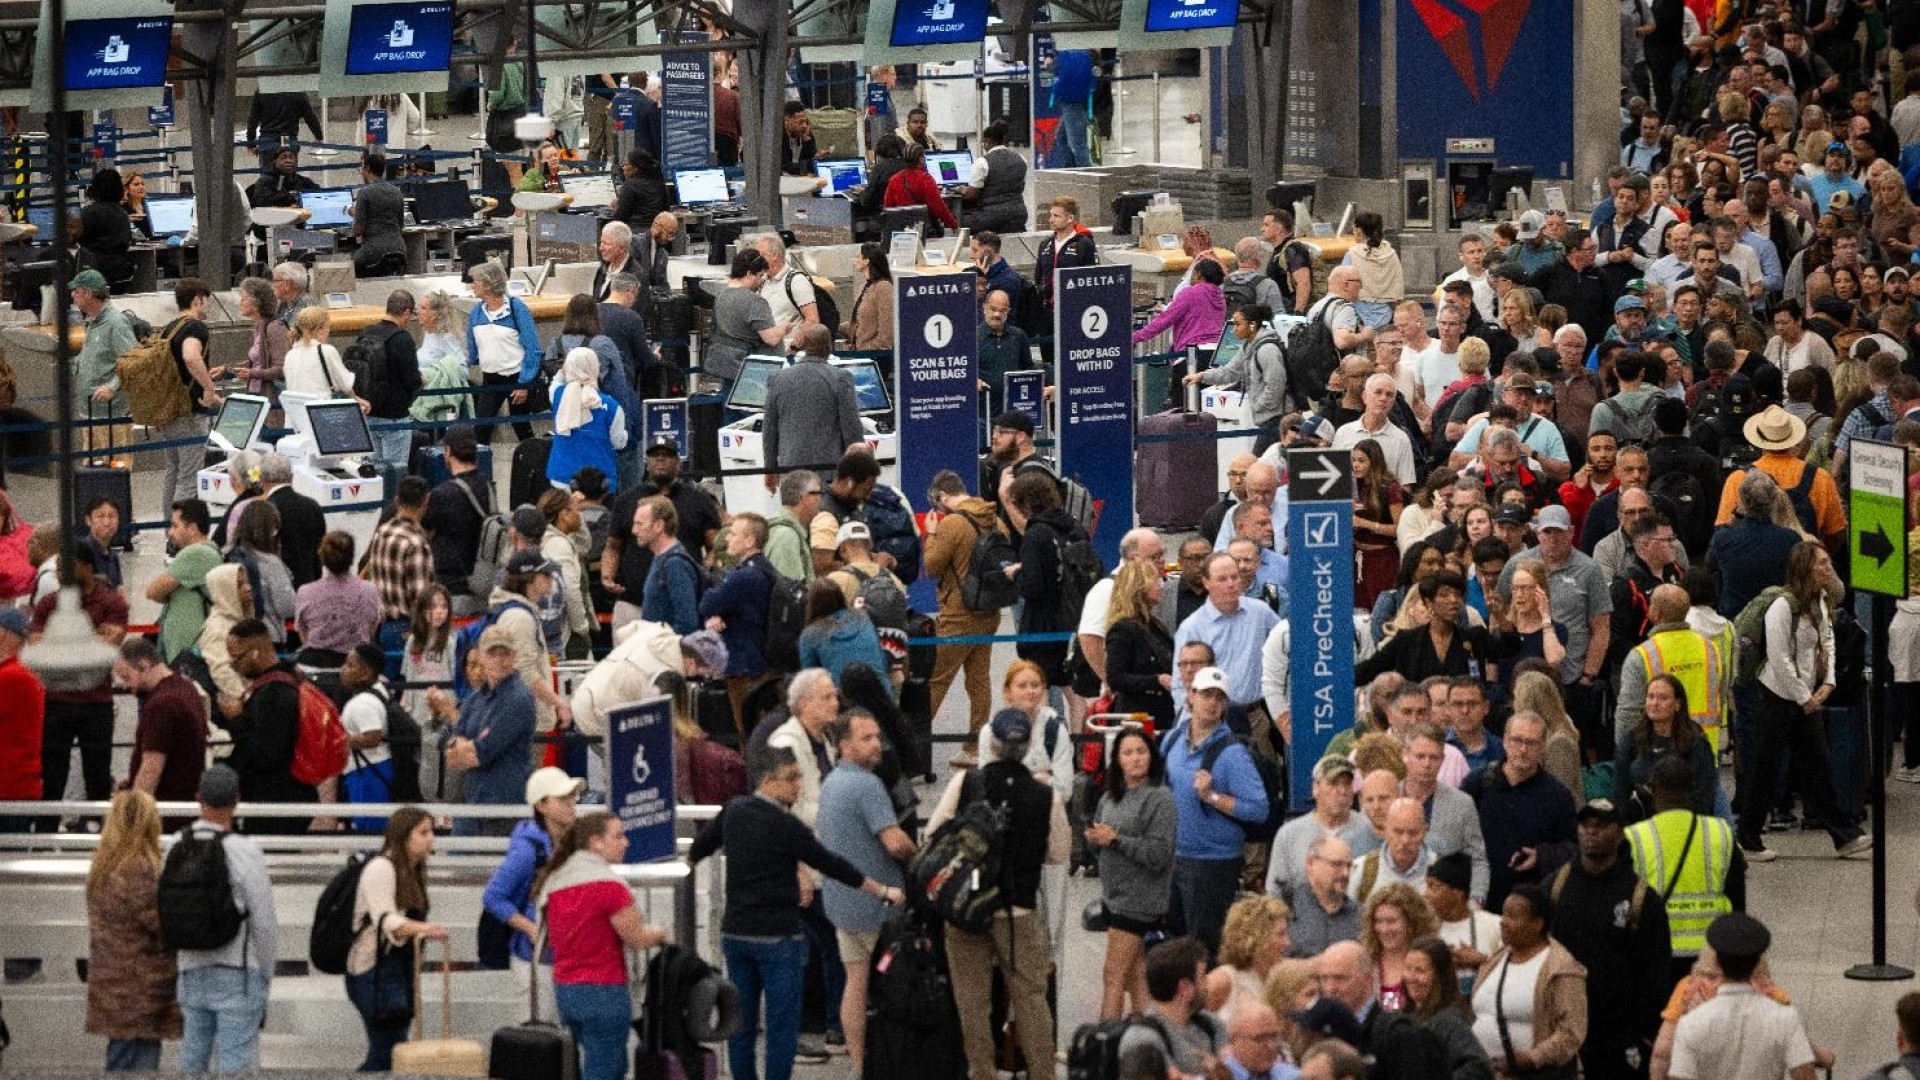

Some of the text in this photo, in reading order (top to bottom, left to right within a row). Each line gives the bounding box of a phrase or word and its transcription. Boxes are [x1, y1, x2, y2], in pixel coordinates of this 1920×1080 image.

[1170, 8, 1217, 18] APP BAG DROP
[917, 23, 965, 33] APP BAG DROP
[373, 51, 426, 60] APP BAG DROP
[87, 66, 141, 77] APP BAG DROP
[667, 61, 700, 71] ADVICE TO
[666, 70, 705, 80] PASSENGERS
[1077, 276, 1115, 287] DELTA
[918, 284, 959, 295] DELTA
[1089, 312, 1100, 332] 2
[934, 320, 942, 341] 1
[1069, 346, 1120, 360] DROP BAGS
[909, 355, 968, 369] SCAN & TAG
[1076, 359, 1113, 372] WITH ID
[911, 368, 967, 381] YOUR BAGS
[1069, 387, 1081, 395] FOR
[1312, 560, 1333, 735] TSA PreCheck
